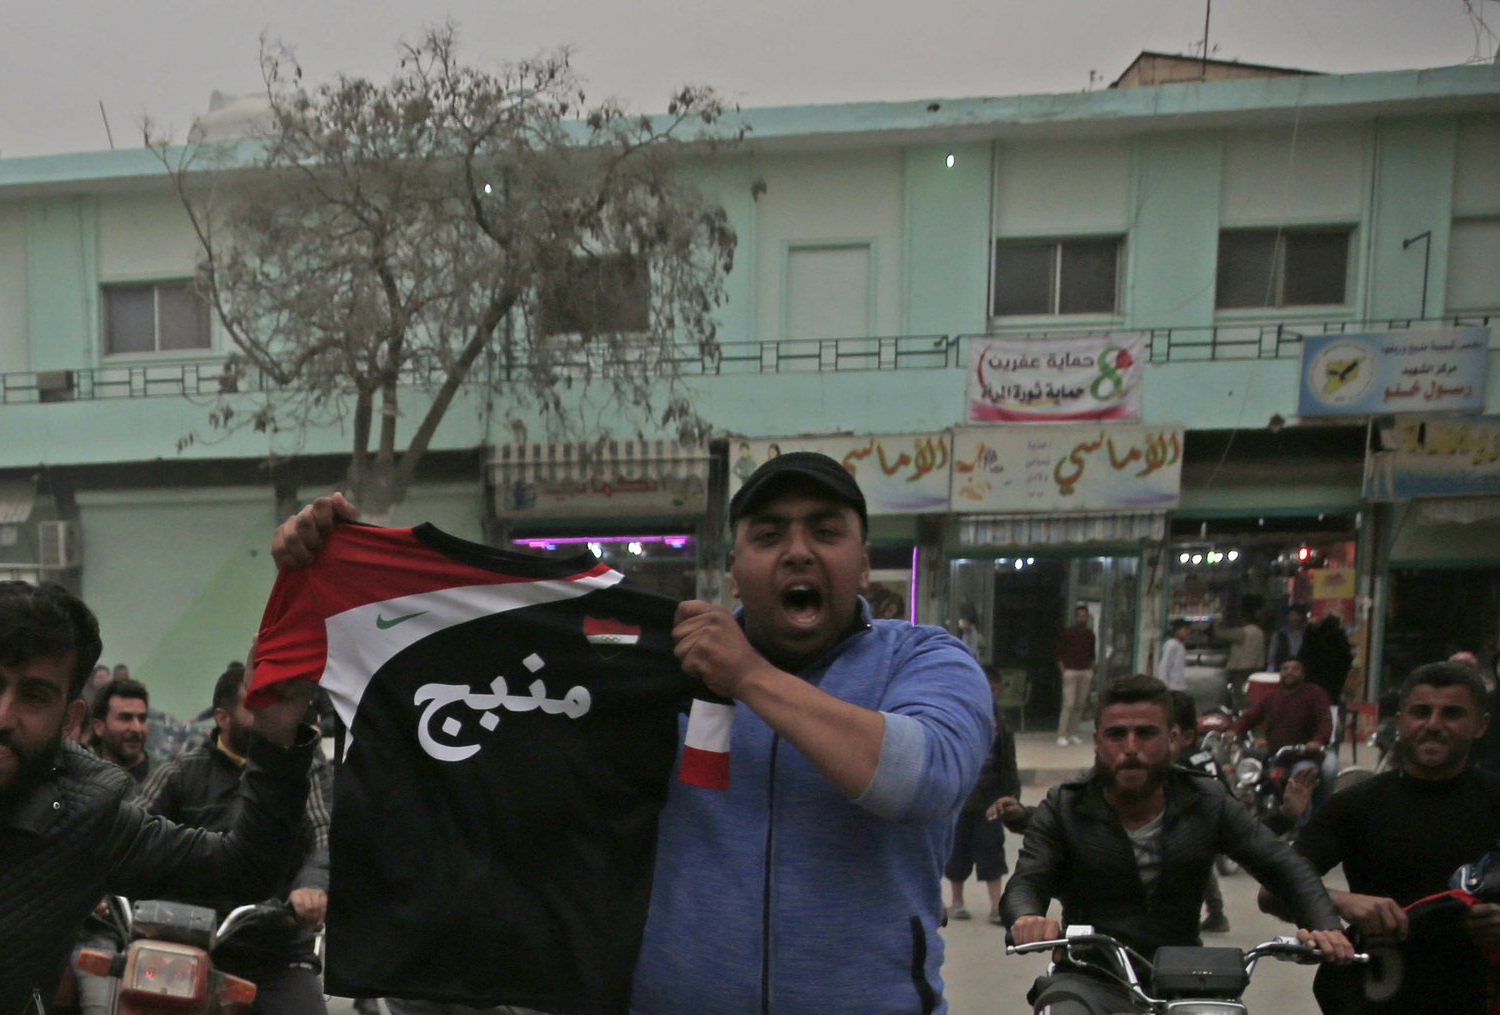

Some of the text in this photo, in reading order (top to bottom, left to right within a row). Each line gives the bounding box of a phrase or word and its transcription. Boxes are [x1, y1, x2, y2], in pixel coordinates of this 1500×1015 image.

[988, 351, 1094, 371] حماية عفرين
[1013, 381, 1042, 402] ثورة
[1045, 386, 1085, 405] حماية
[414, 652, 591, 762] منبج
